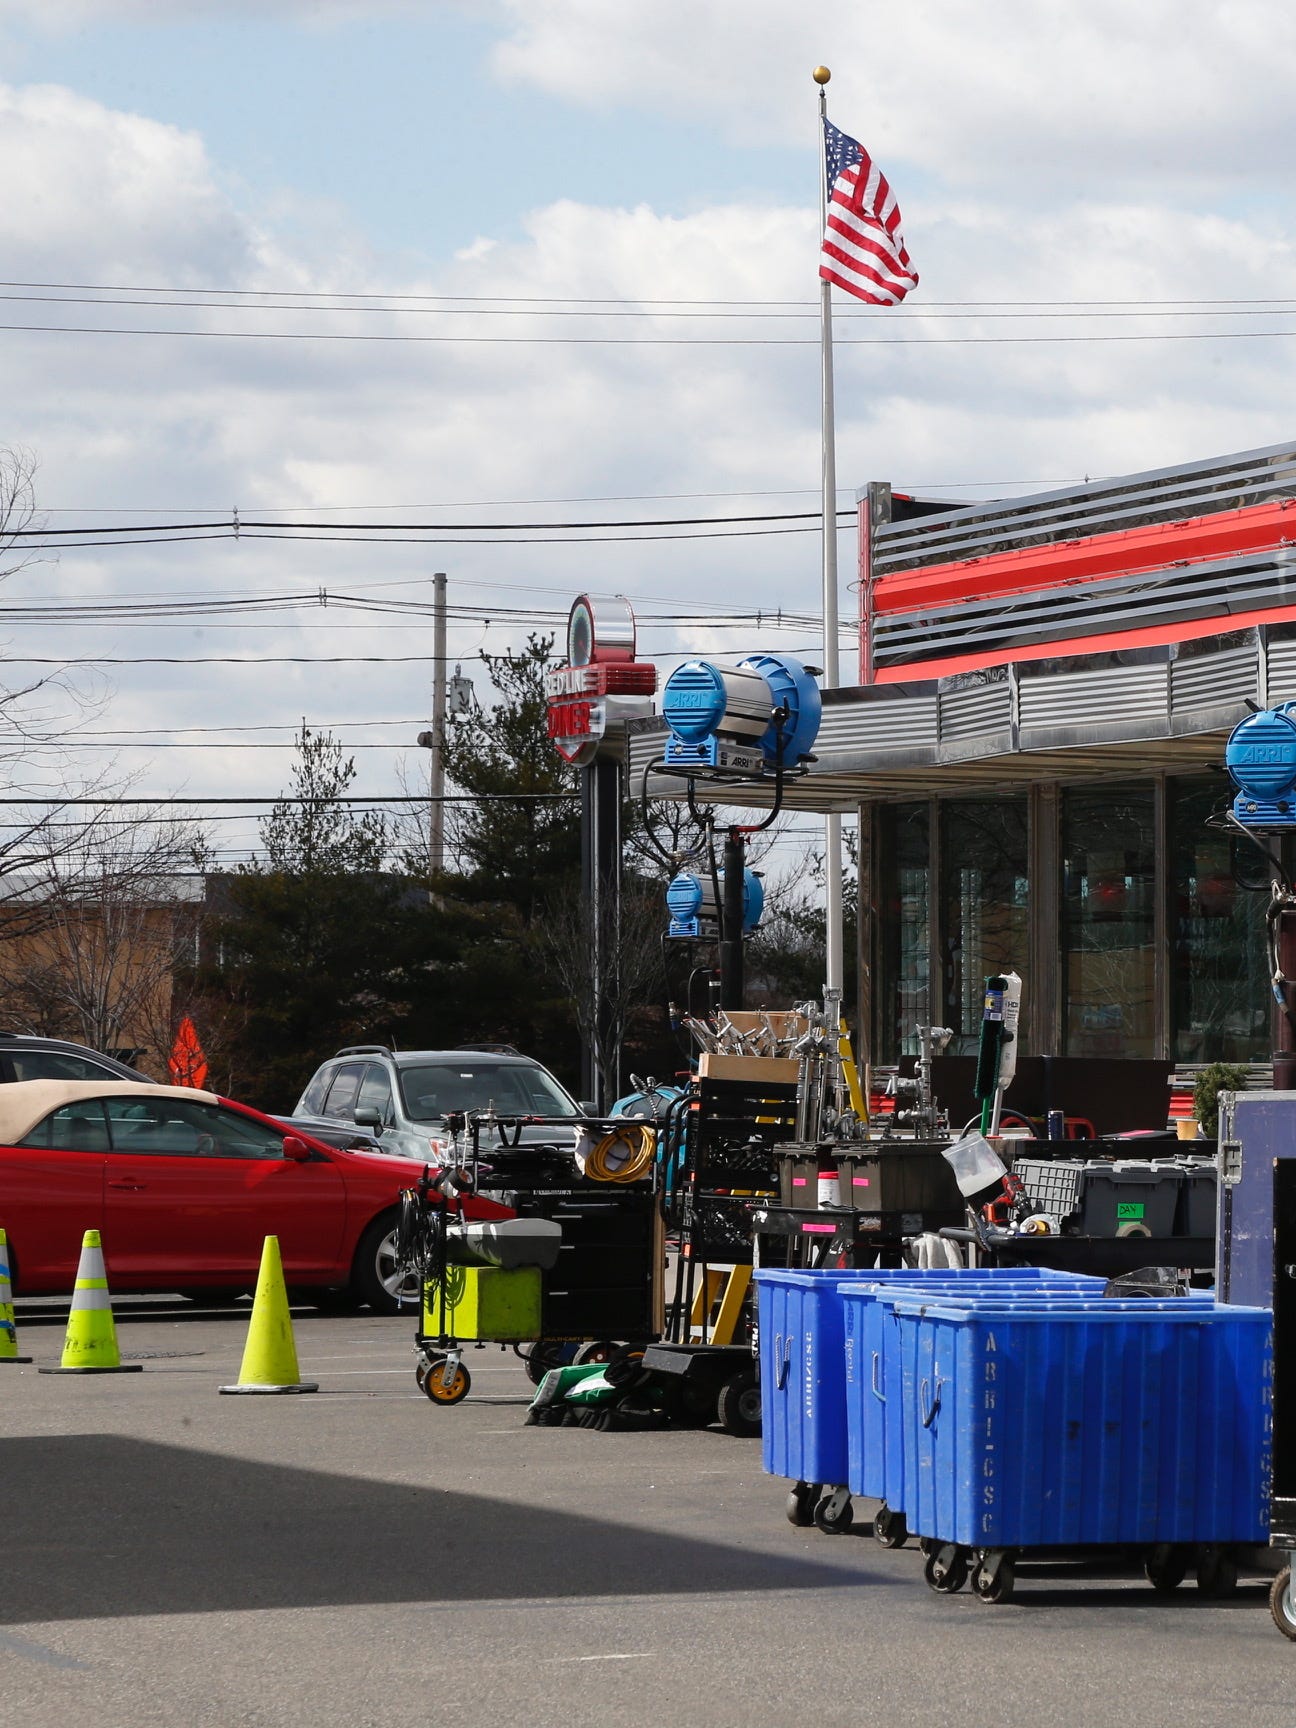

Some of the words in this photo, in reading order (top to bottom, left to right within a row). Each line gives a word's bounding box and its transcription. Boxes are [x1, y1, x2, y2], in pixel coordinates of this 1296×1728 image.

[669, 692, 703, 708] ARRI
[547, 702, 590, 738] DINER
[731, 756, 750, 768] ARRI
[1241, 745, 1283, 763] ARRI
[1119, 1205, 1137, 1215] DAY
